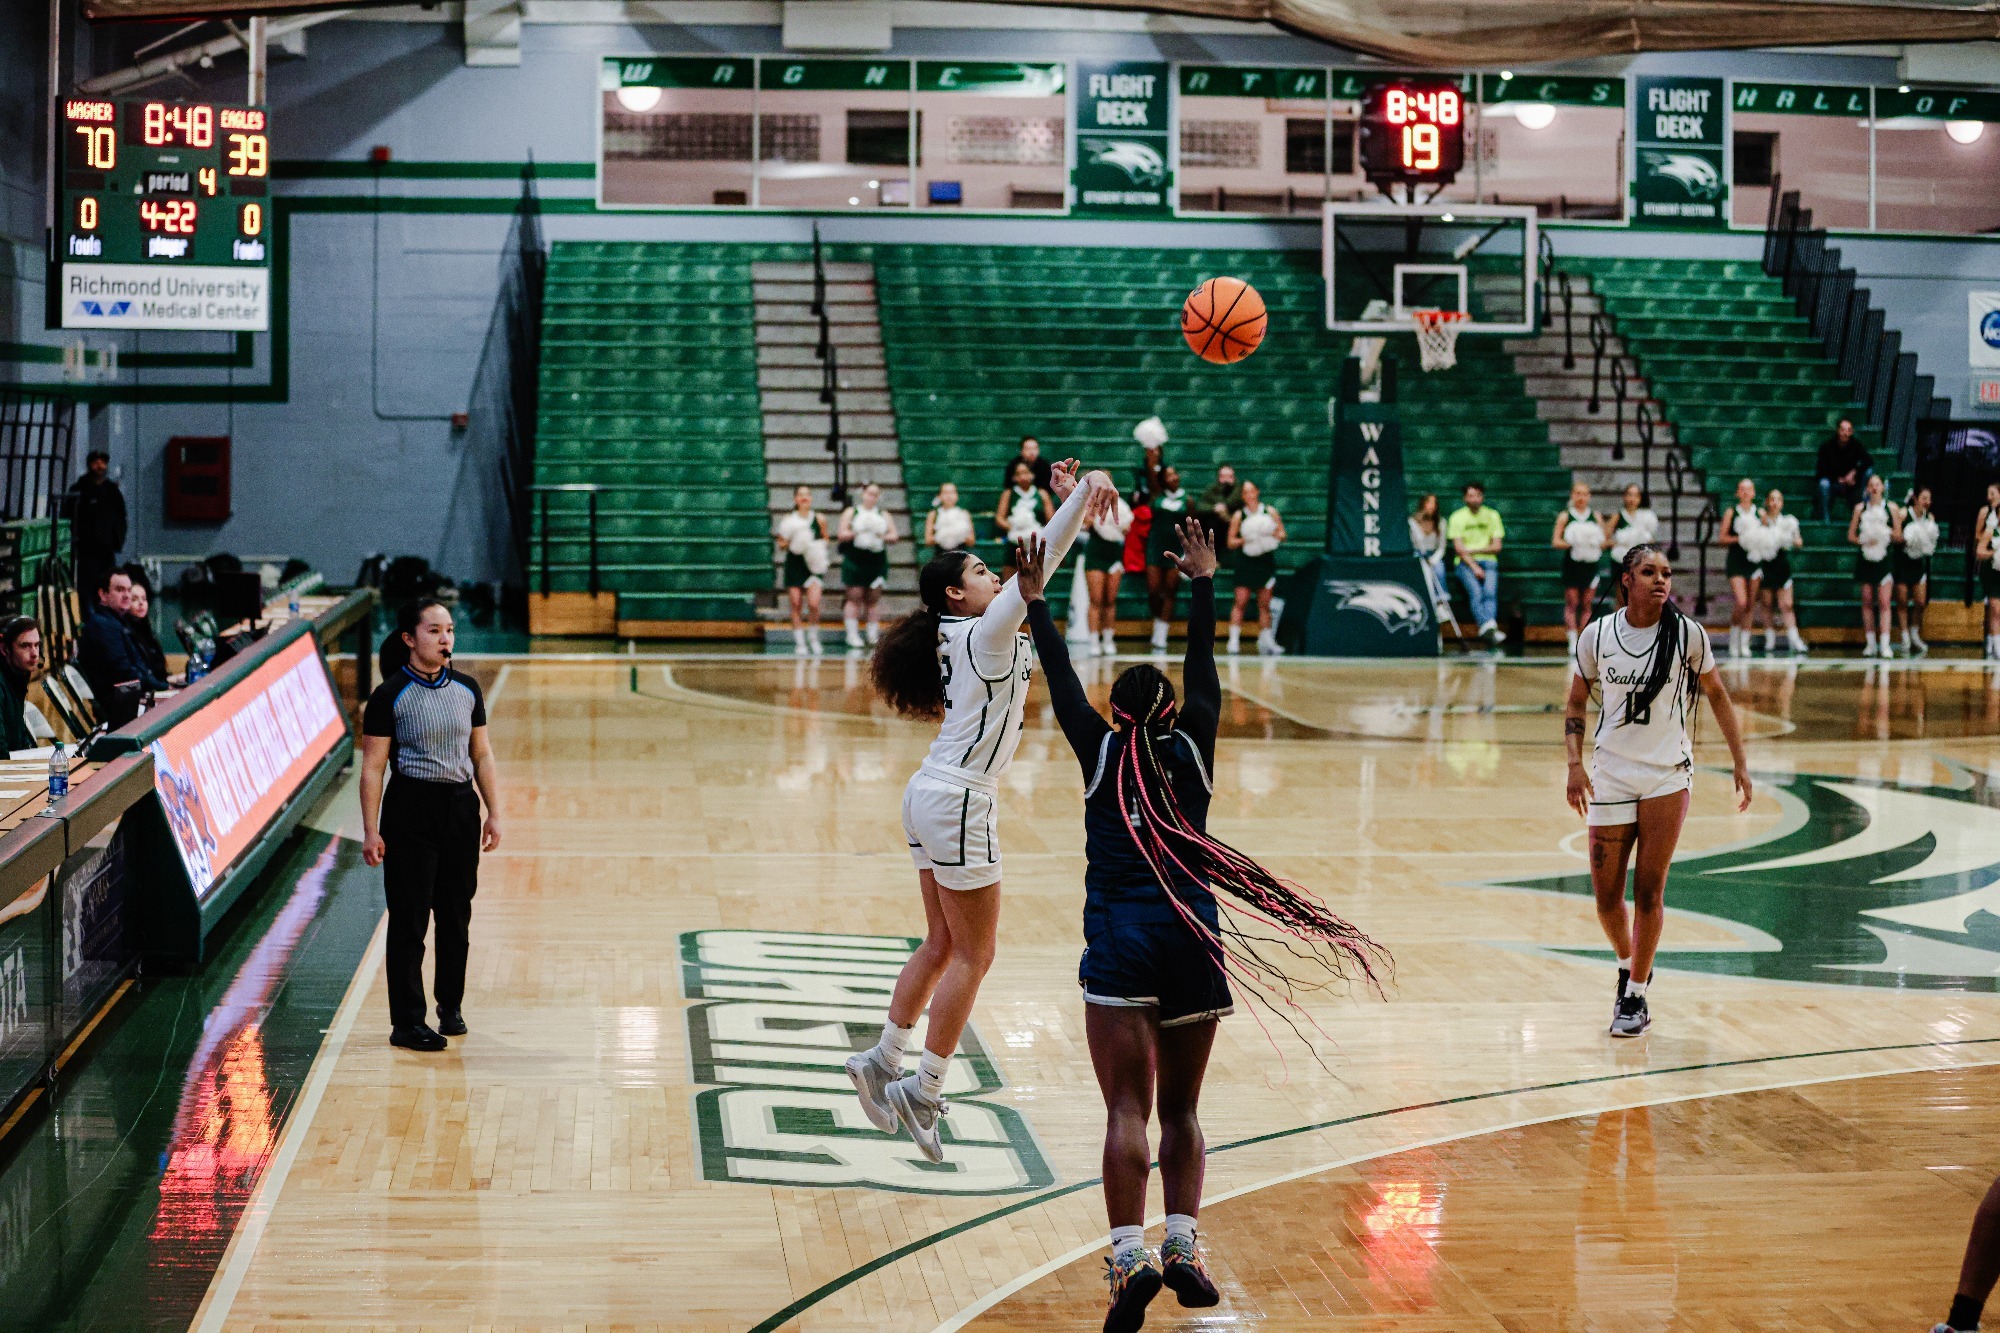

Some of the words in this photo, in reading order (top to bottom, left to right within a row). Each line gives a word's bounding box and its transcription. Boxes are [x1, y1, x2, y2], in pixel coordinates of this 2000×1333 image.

[1089, 74, 1156, 98] FLIGHT
[1188, 72, 1611, 101] ATHLICS
[67, 101, 114, 121] WAGNER
[1097, 101, 1148, 125] DECK
[1386, 90, 1458, 125] 8:48
[1648, 87, 1711, 113] FLIGHT
[1737, 90, 1862, 111] HALL
[1916, 96, 1968, 114] OF
[144, 103, 213, 147] 8:48
[220, 110, 265, 130] EAGLES
[1656, 113, 1703, 140] DECK
[76, 126, 115, 169] 70
[228, 134, 267, 176] 39
[1402, 124, 1440, 170] 19
[148, 172, 189, 194] period
[199, 167, 216, 196] 4
[80, 197, 98, 230] 0
[243, 203, 261, 235] 0
[69, 235, 101, 256] fouls
[70, 276, 161, 296] Richmond
[167, 279, 260, 300] University
[143, 302, 200, 318] Medical
[206, 303, 259, 320] Center
[1359, 422, 1383, 557] WAGNER
